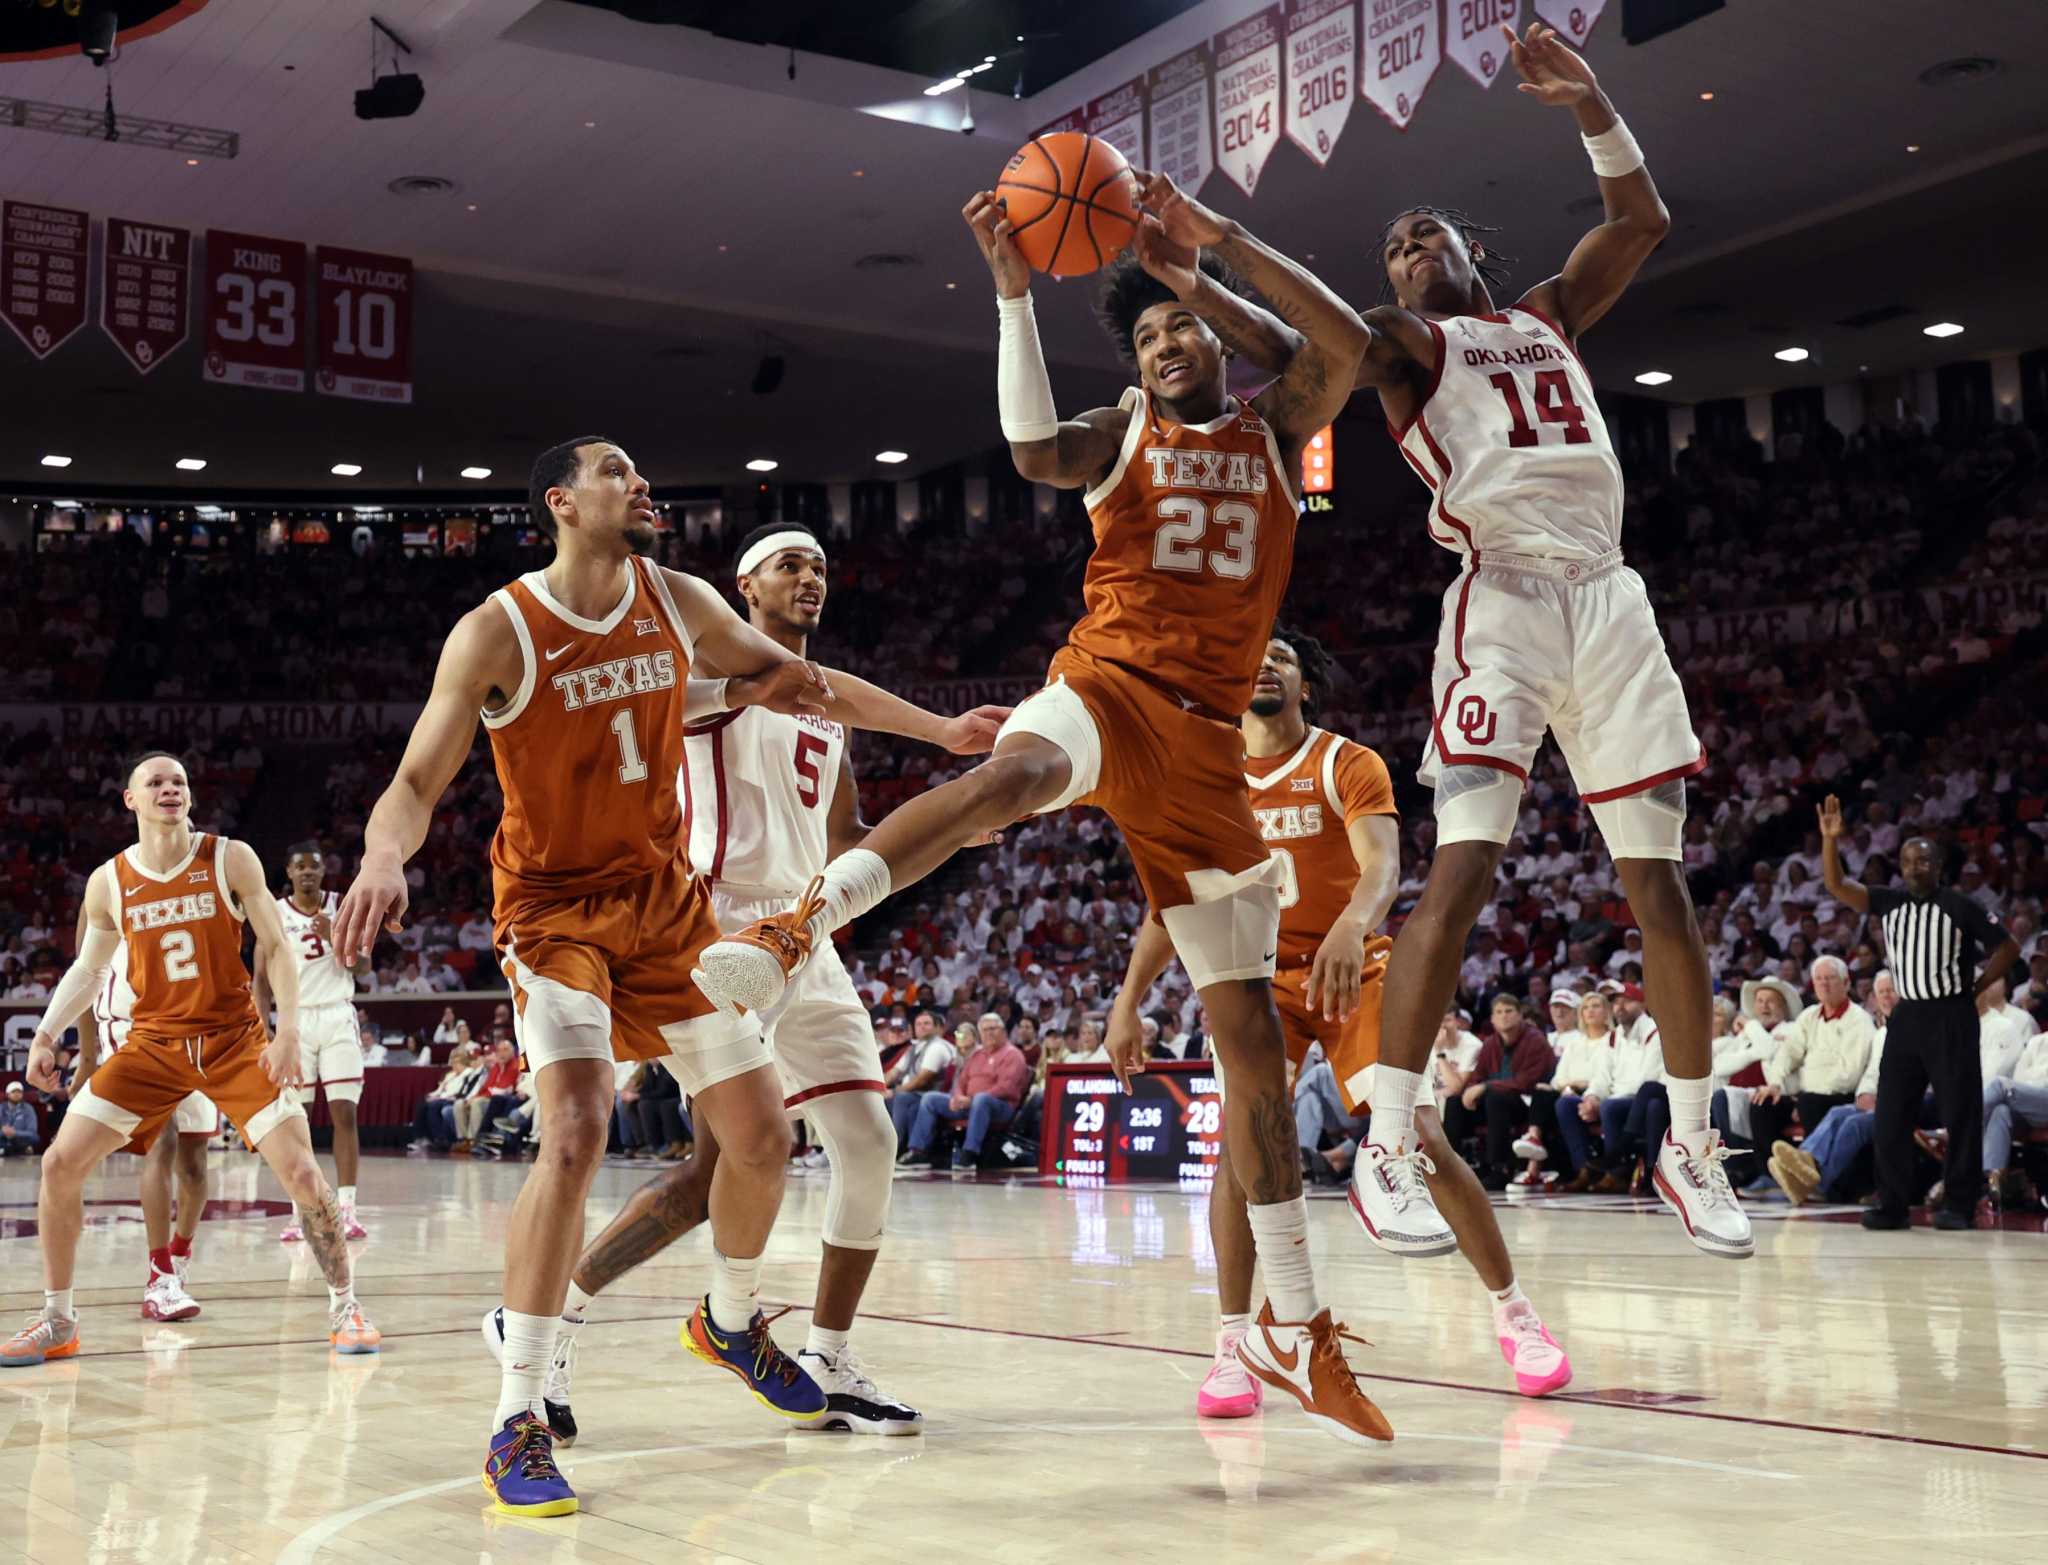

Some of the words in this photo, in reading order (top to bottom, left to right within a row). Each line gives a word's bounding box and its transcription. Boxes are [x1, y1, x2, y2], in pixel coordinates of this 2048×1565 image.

[1295, 20, 1347, 56] NATIONAL
[1378, 24, 1425, 80] 2017
[1298, 65, 1347, 119] 2016
[1223, 101, 1270, 153] 2014
[122, 225, 176, 261] NIT
[233, 248, 281, 273] KING
[322, 263, 408, 292] BLAYLOCK
[215, 272, 296, 347] 33
[333, 289, 396, 360] 10
[1489, 369, 1592, 448] 14
[1145, 447, 1268, 495] TEXAS
[1153, 495, 1259, 581] 23
[552, 650, 677, 712] TEXAS
[1457, 695, 1498, 746] OU
[611, 707, 648, 784] 1
[793, 729, 828, 810] 5
[1252, 804, 1323, 841] XAS
[126, 892, 216, 933] TEXAS
[159, 929, 200, 983] 2
[301, 933, 325, 960] 3
[1066, 1079, 1116, 1094] OKLAHOMA
[1073, 1101, 1105, 1132] 29
[1129, 1107, 1162, 1127] 2:36
[1186, 1101, 1220, 1133] 28
[1132, 1136, 1155, 1151] 1ST
[1065, 1160, 1097, 1173] FOULS
[1179, 1163, 1213, 1177] FOULS
